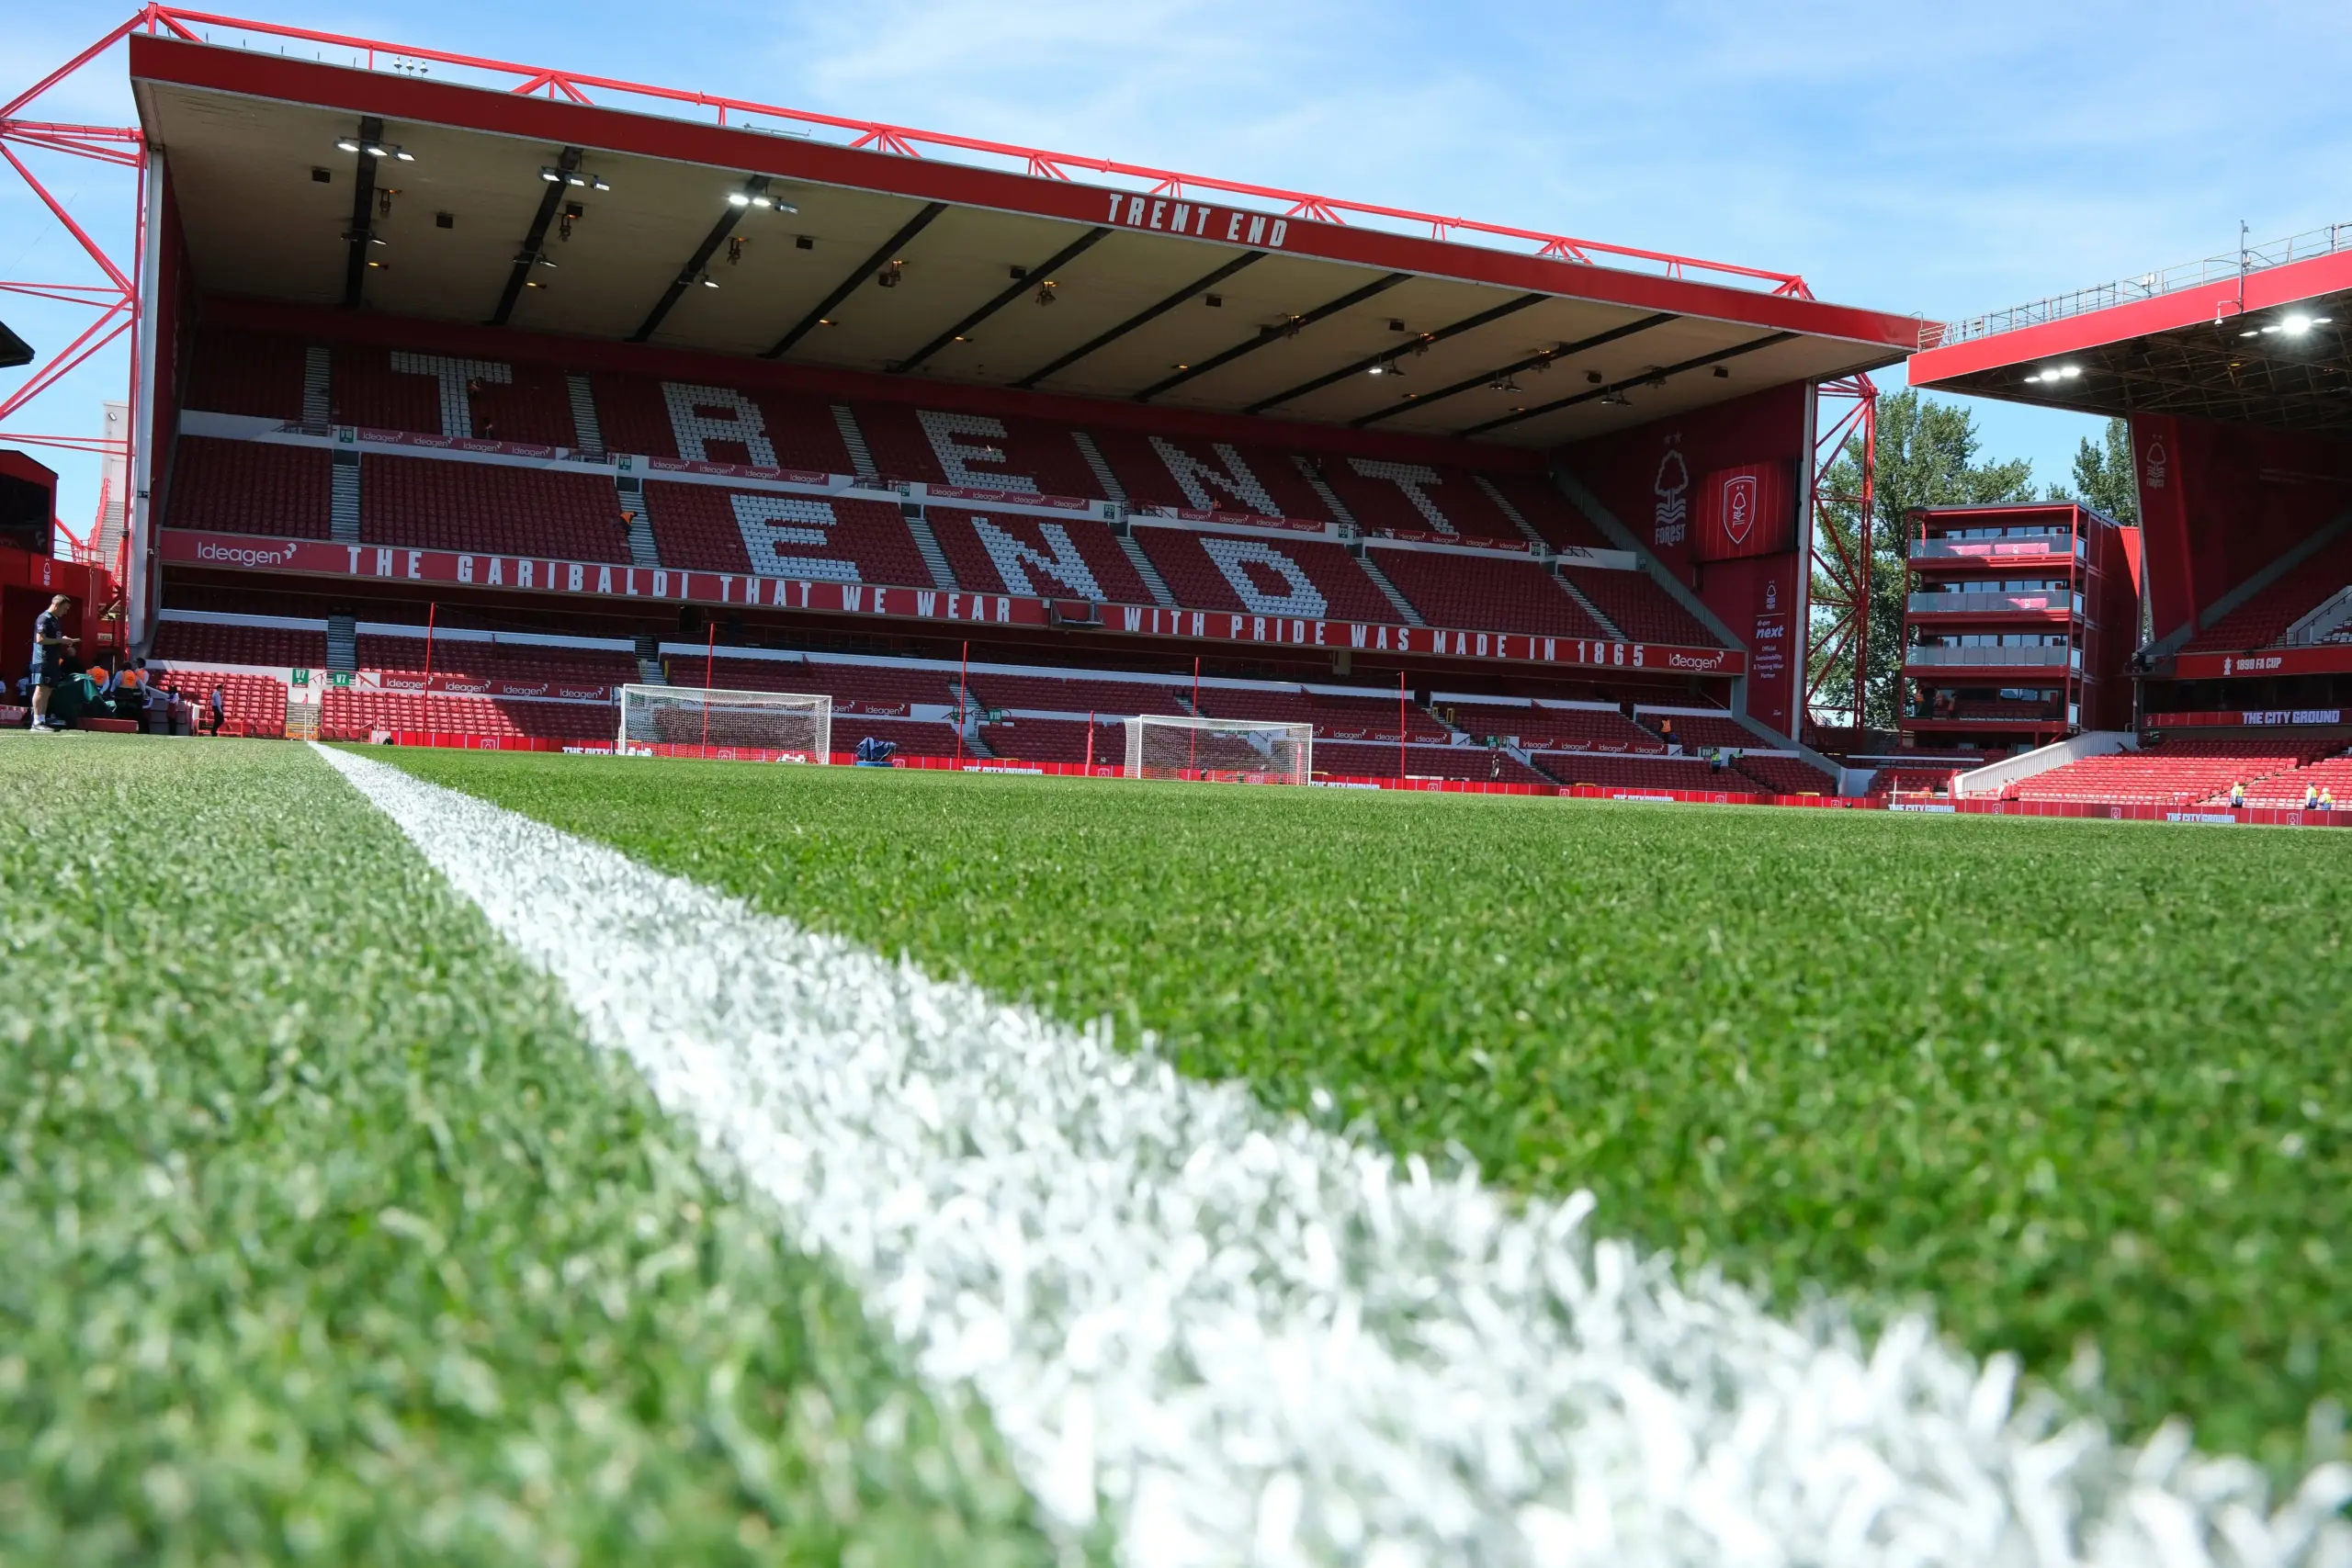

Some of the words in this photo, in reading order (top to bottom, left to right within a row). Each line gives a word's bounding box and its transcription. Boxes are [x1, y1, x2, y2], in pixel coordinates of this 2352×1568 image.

[1108, 193, 1211, 235] TRENT
[1227, 212, 1288, 247] END
[363, 431, 399, 443] Ideagen
[414, 436, 447, 448] Ideagen
[463, 441, 497, 453] Ideagen
[512, 446, 546, 457] Ideagen
[653, 459, 684, 471] Ideagen
[699, 464, 731, 475] Ideagen
[745, 468, 776, 479] Ideagen
[789, 473, 820, 484] Ideagen
[932, 487, 960, 498] Ideagen
[973, 491, 1001, 502] Ideagen
[1013, 495, 1042, 506] Ideagen
[1054, 500, 1081, 510] Ideagen
[1182, 511, 1208, 522] Ideagen
[1219, 514, 1245, 525] Ideagen
[1256, 518, 1282, 529] Ideagen
[1292, 522, 1318, 533] Ideagen
[1398, 533, 1421, 542] Ideagen
[1432, 536, 1455, 545] Ideagen
[1465, 539, 1489, 548] Ideagen
[1499, 542, 1522, 552] Ideagen
[198, 542, 281, 567] Ideagen
[347, 546, 423, 579] THE
[458, 555, 689, 599] GARIBALDI
[719, 575, 811, 608] THAT
[842, 584, 887, 614] WE
[917, 591, 1010, 623] WEAR
[1124, 606, 1204, 637] WITH
[1231, 615, 1326, 645] PRIDE
[1351, 624, 1409, 651] WAS
[1433, 630, 1507, 658] MADE
[1530, 637, 1555, 660] IN
[1577, 641, 1644, 667] 1865
[1756, 625, 1784, 638] next
[1668, 653, 1717, 671] Ideagen
[2256, 659, 2265, 670] FA
[2266, 657, 2281, 669] CUP
[296, 669, 306, 679] V7
[336, 674, 346, 683] V7
[387, 678, 426, 691] Ideagen
[445, 681, 486, 694] Ideagen
[503, 684, 543, 697] Ideagen
[560, 688, 599, 700] Ideagen
[865, 705, 899, 716] Ideagen
[2243, 712, 2263, 725] THE
[2265, 711, 2290, 724] CITY
[2292, 710, 2340, 724] GROUND
[1333, 730, 1363, 740] Ideagen
[1415, 735, 1443, 744] Ideagen
[1523, 739, 1549, 750] Ideagen
[1561, 742, 1588, 751] Ideagen
[1599, 743, 1623, 752] Ideagen
[1634, 746, 1660, 755] Ideagen
[2166, 812, 2181, 821] THE
[2182, 813, 2200, 822] CITY
[2201, 814, 2235, 824] GROUND
